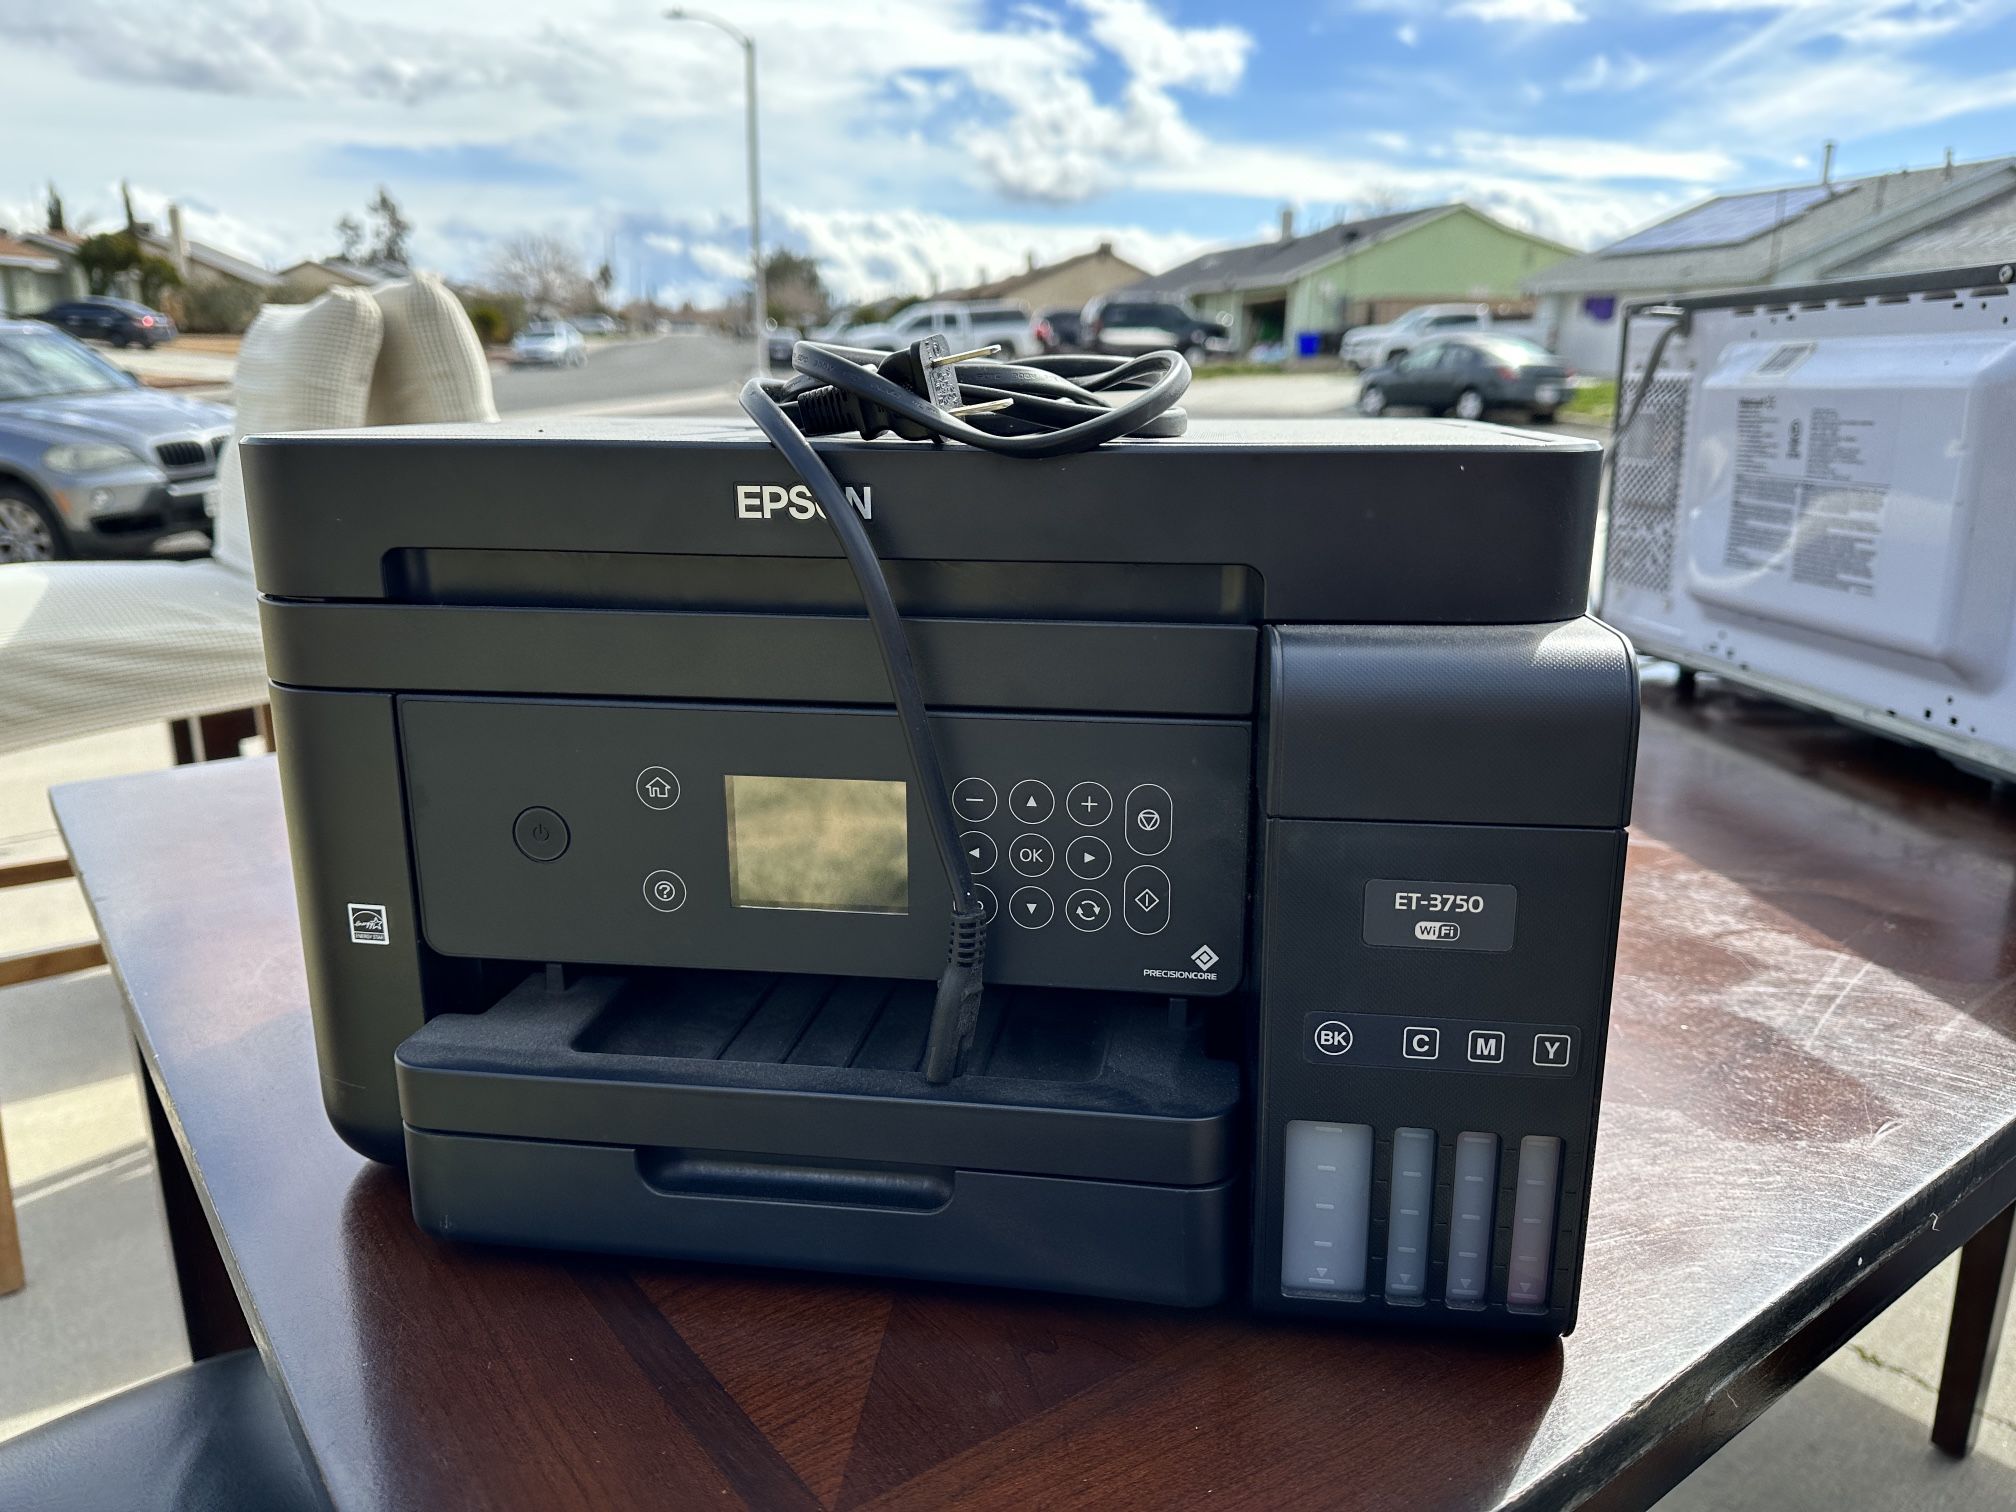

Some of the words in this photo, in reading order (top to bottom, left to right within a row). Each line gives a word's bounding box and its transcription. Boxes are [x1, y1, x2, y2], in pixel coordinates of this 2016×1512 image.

[736, 485, 872, 520] EPSN
[1019, 848, 1044, 863] OK
[1394, 892, 1484, 913] ET-3750
[1143, 968, 1218, 981] PRECISIONCORE
[1320, 1031, 1347, 1046] BK
[1412, 1034, 1430, 1052] C
[1476, 1037, 1496, 1056] M
[1544, 1041, 1561, 1060] Y
